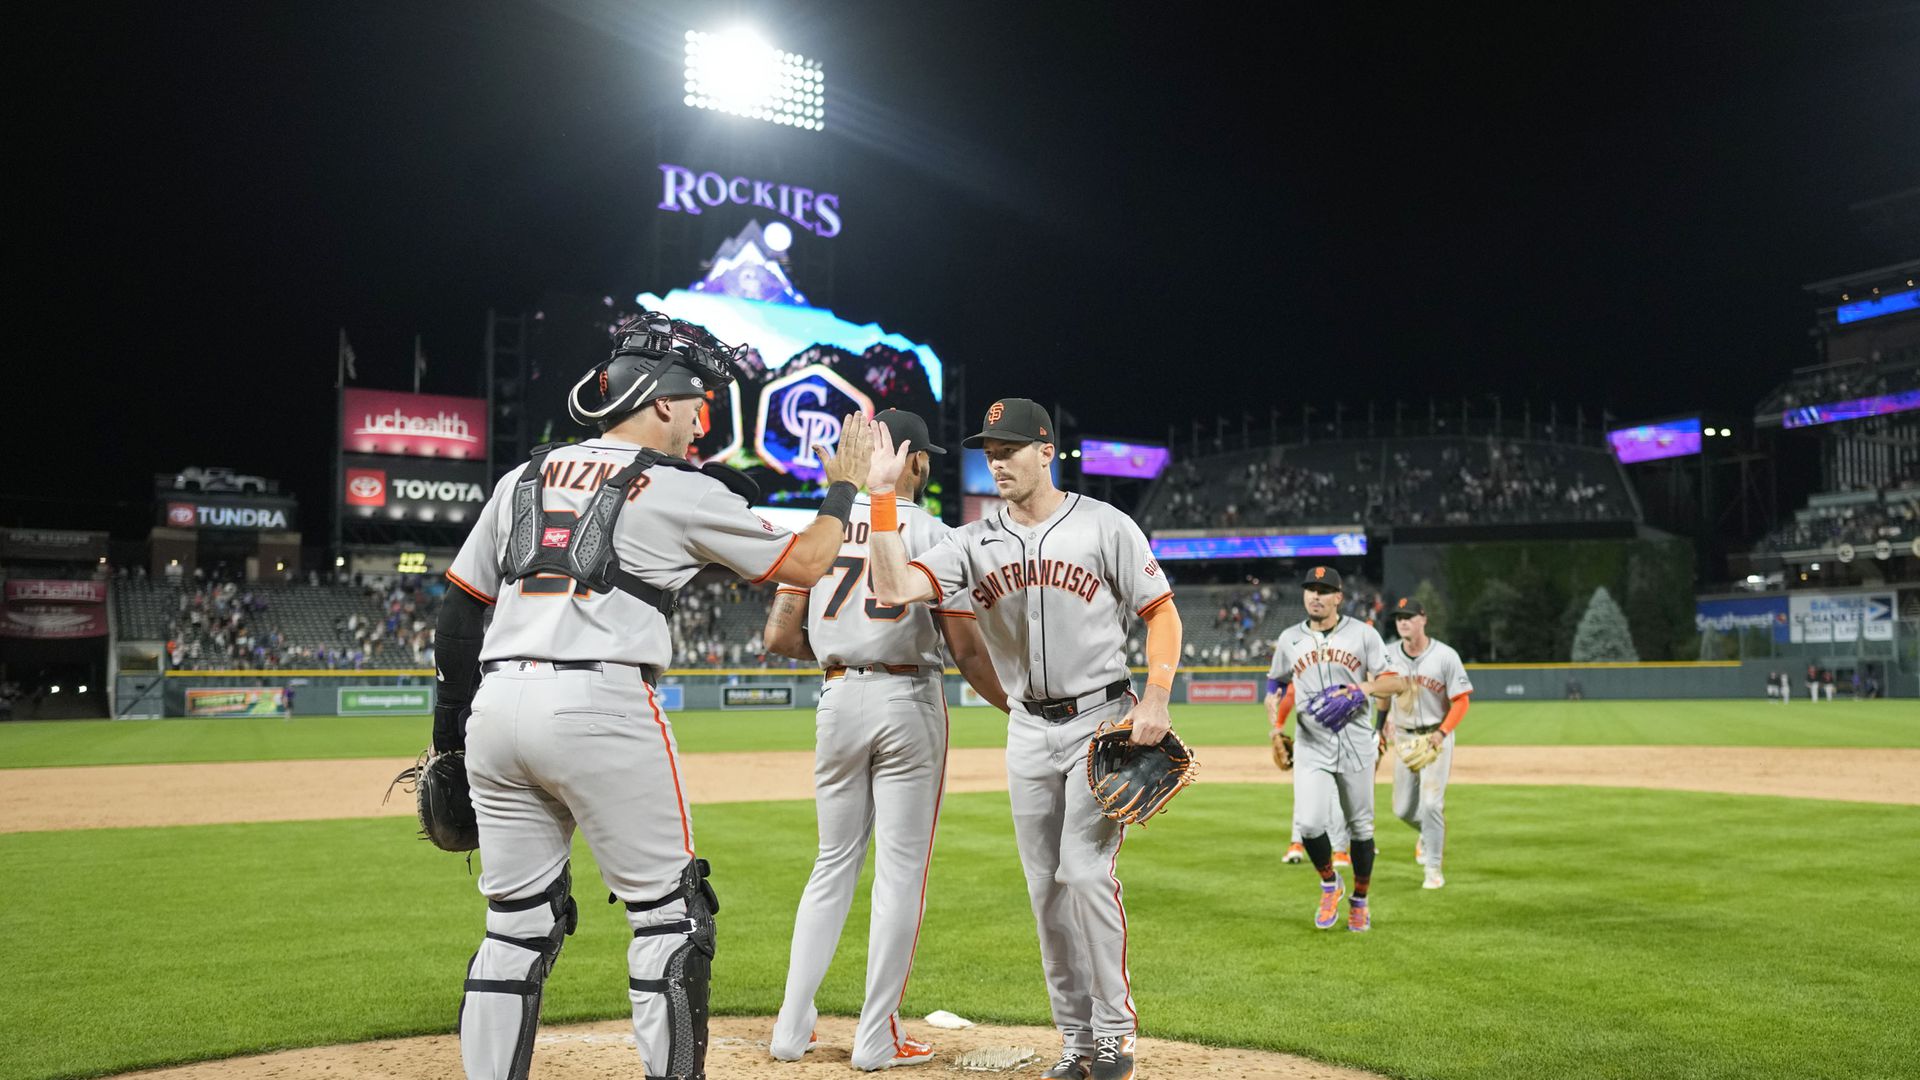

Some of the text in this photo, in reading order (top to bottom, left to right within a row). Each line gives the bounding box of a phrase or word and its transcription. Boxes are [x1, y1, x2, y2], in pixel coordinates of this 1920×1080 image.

[658, 163, 842, 238] ROCKIES
[365, 409, 468, 438] uchealth
[988, 402, 1004, 425] SF
[392, 479, 485, 502] TOYOTA
[542, 460, 652, 503] NIZNR
[197, 506, 287, 528] TUNDRA
[972, 558, 1101, 610] SAN FRANCISCO
